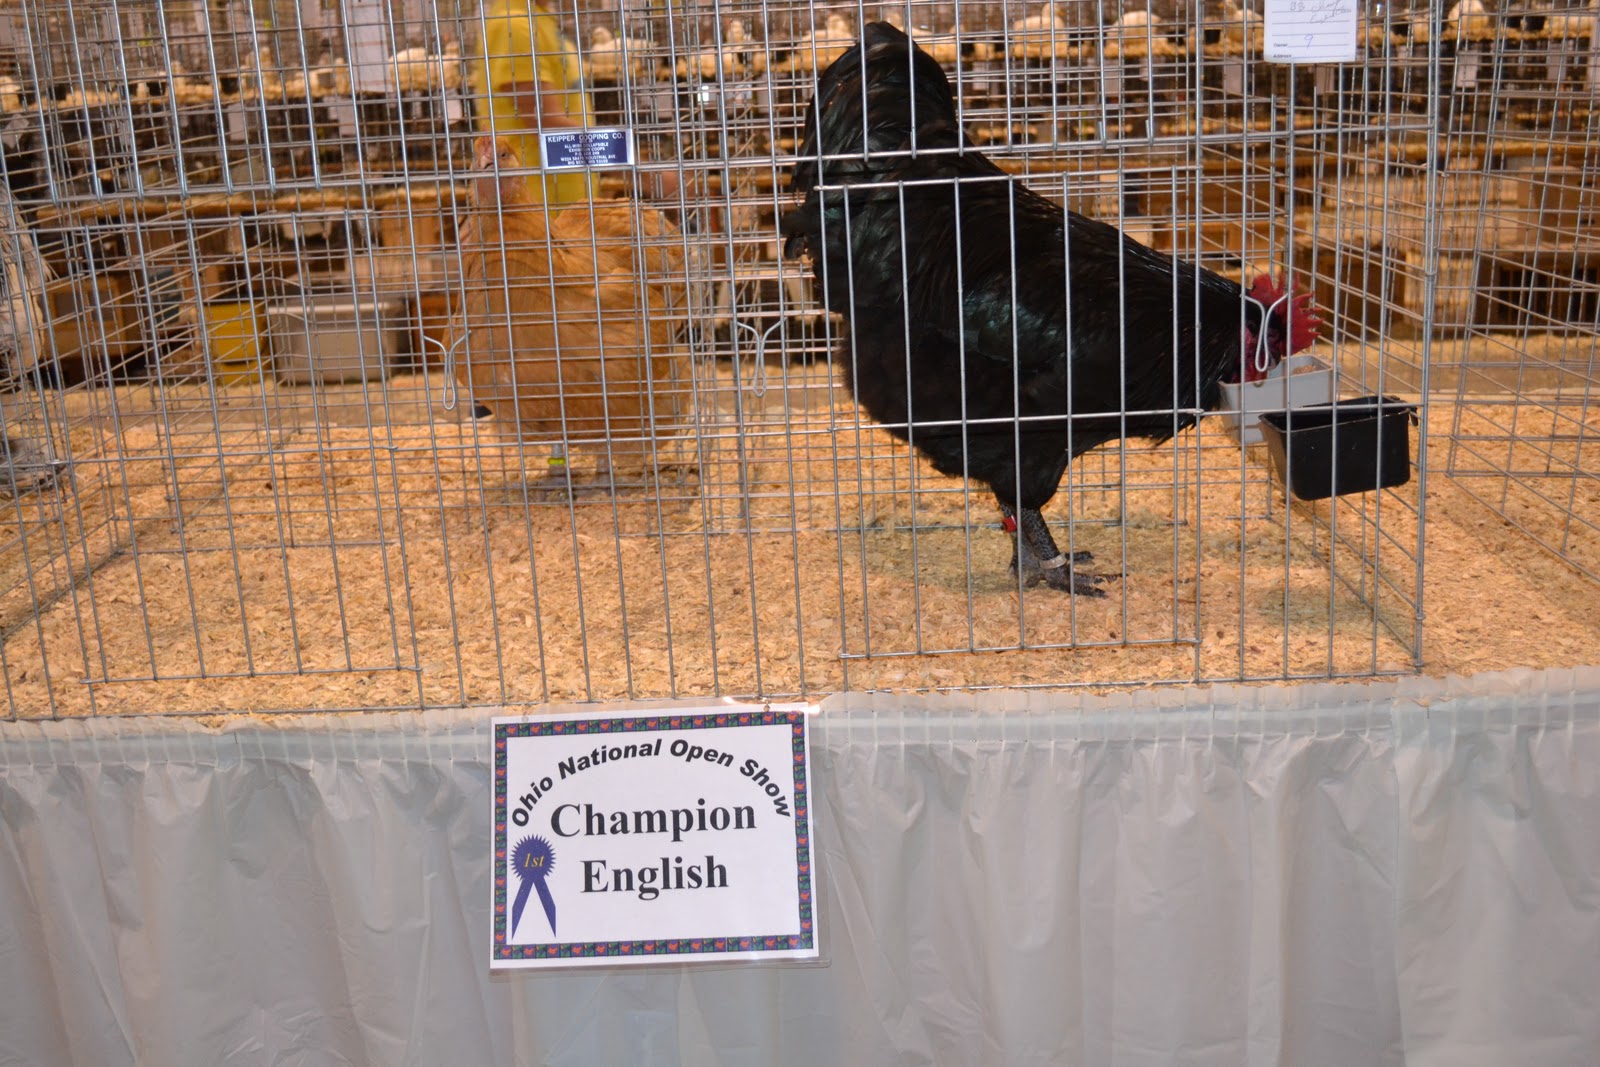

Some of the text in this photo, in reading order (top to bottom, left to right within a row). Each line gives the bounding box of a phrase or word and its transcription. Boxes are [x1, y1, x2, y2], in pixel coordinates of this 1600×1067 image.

[547, 134, 576, 143] KEIPPER
[578, 133, 609, 141] COOPING
[612, 132, 624, 140] CO.
[511, 739, 791, 827] Ohio National Open Show
[550, 798, 757, 842] Champion
[523, 852, 545, 868] 1st
[581, 856, 729, 901] English
